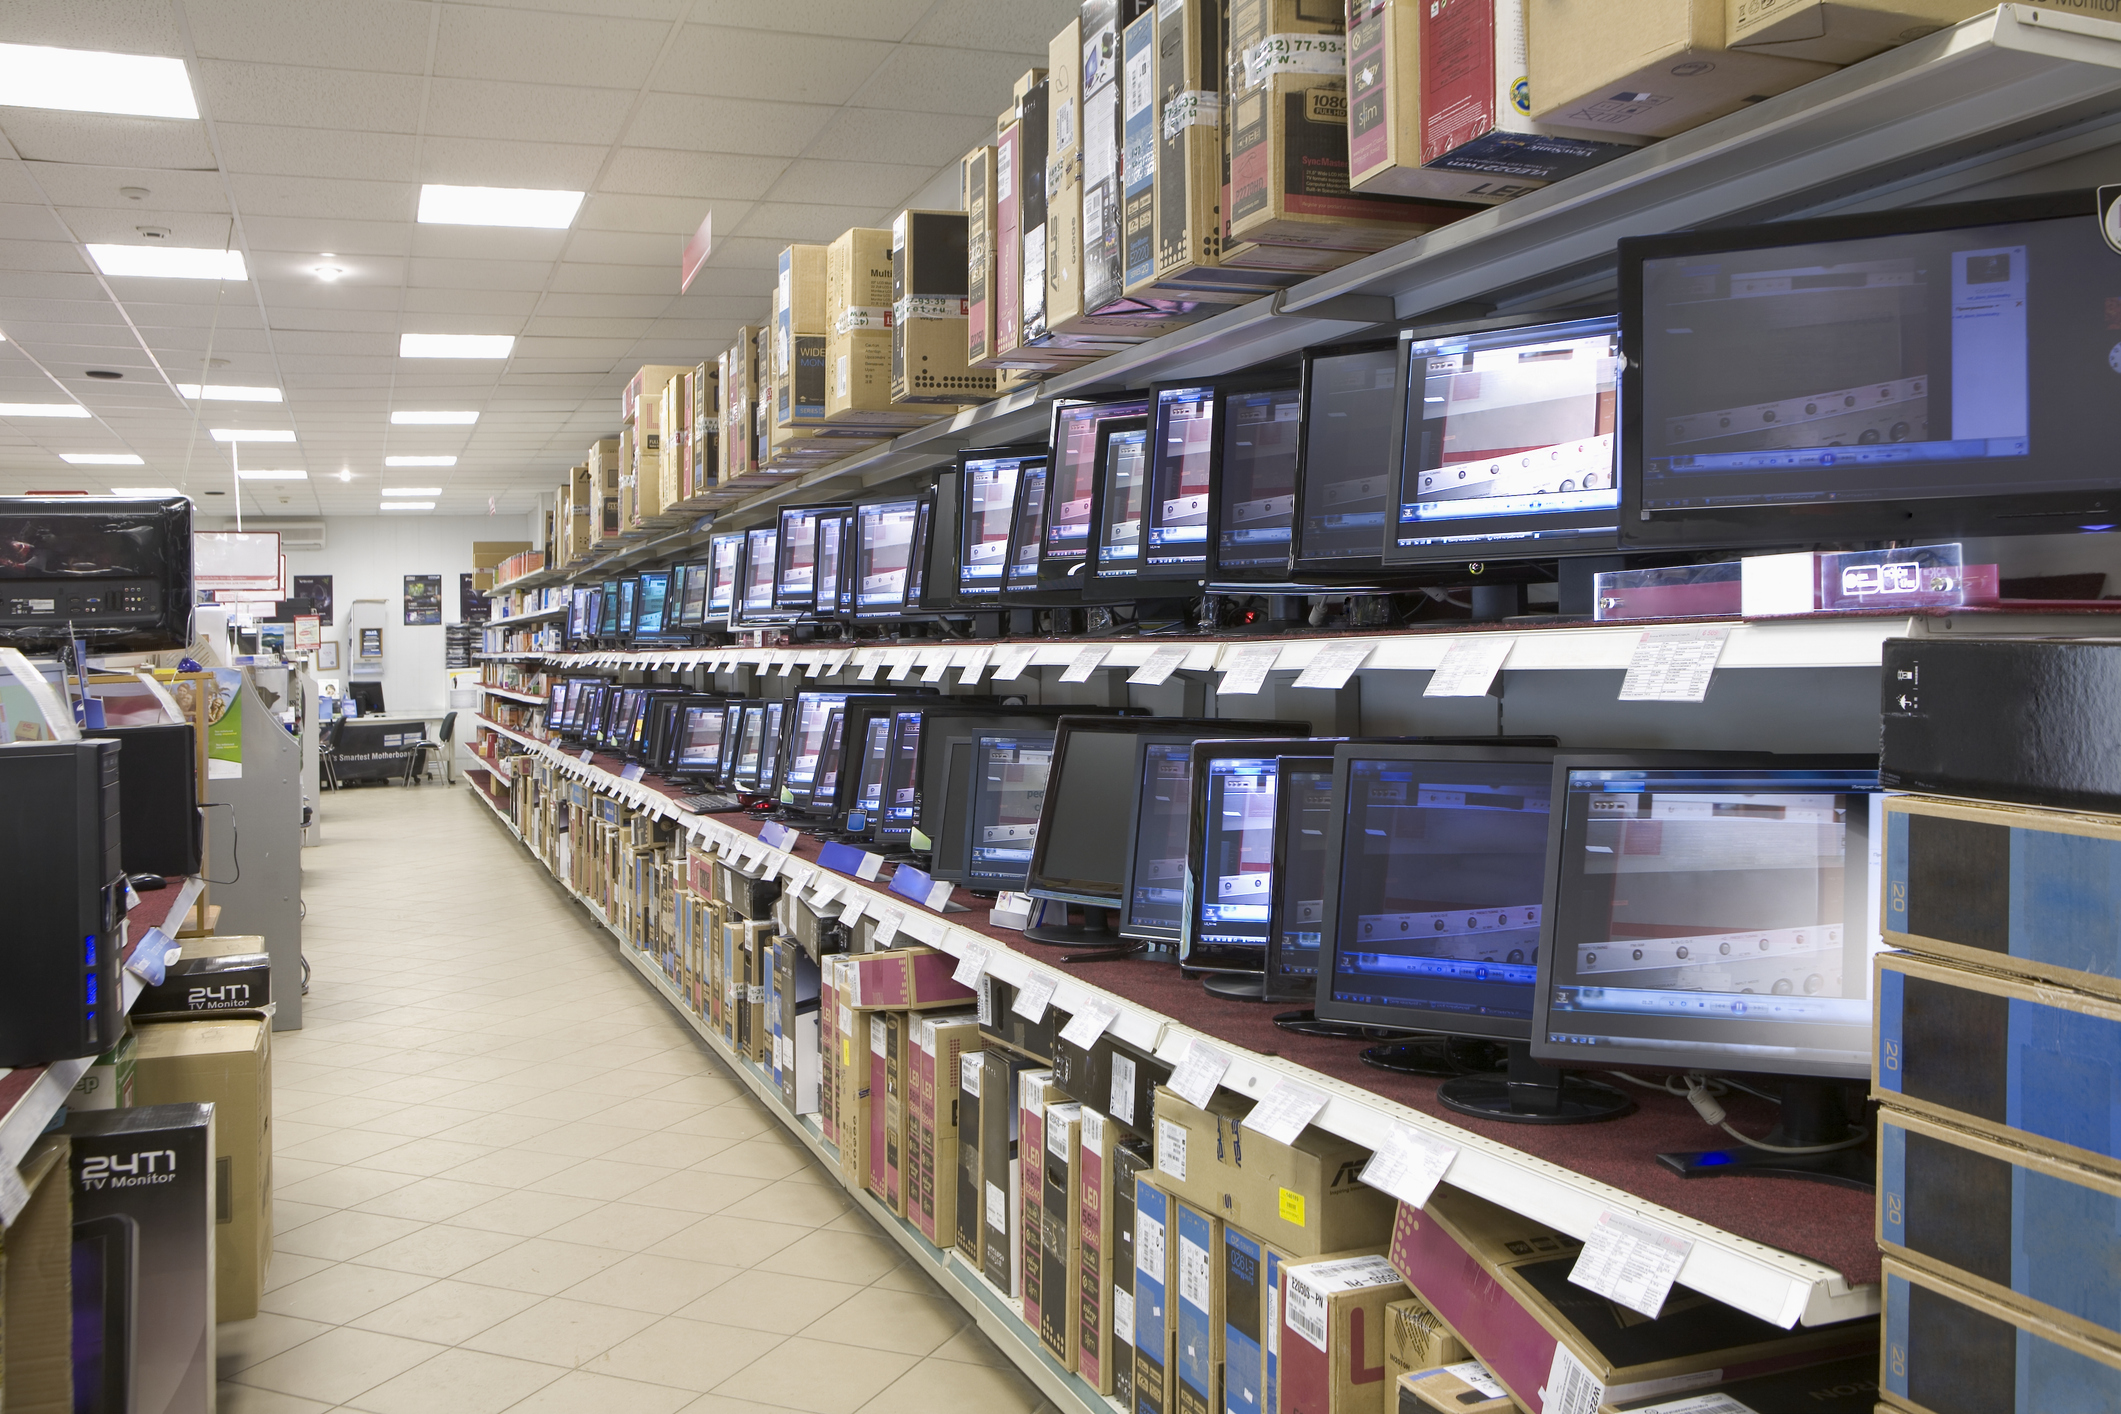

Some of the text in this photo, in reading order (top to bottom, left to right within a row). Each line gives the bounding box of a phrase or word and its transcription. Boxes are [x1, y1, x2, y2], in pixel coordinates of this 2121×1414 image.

[1316, 107, 1332, 115] FULL
[1358, 102, 1378, 129] slim
[1302, 156, 1348, 168] SyncMaster
[1050, 214, 1059, 292] ASUS
[800, 347, 826, 357] WIDE
[800, 358, 825, 367] MON
[339, 753, 370, 762] Smartest
[1892, 883, 1905, 913] 20
[188, 999, 250, 1011] TV Monitor
[1886, 1042, 1898, 1071] 20
[909, 1066, 920, 1089] LED
[922, 1077, 933, 1100] LED
[1026, 1142, 1040, 1168] LED
[82, 1171, 176, 1192] TV Monitor
[1026, 1182, 1041, 1202] E2240
[1082, 1182, 1099, 1211] LED
[1889, 1196, 1901, 1225] 20
[1082, 1225, 1099, 1246] E2240
[1231, 1249, 1254, 1277] E1920
[1892, 1347, 1904, 1377] 20
